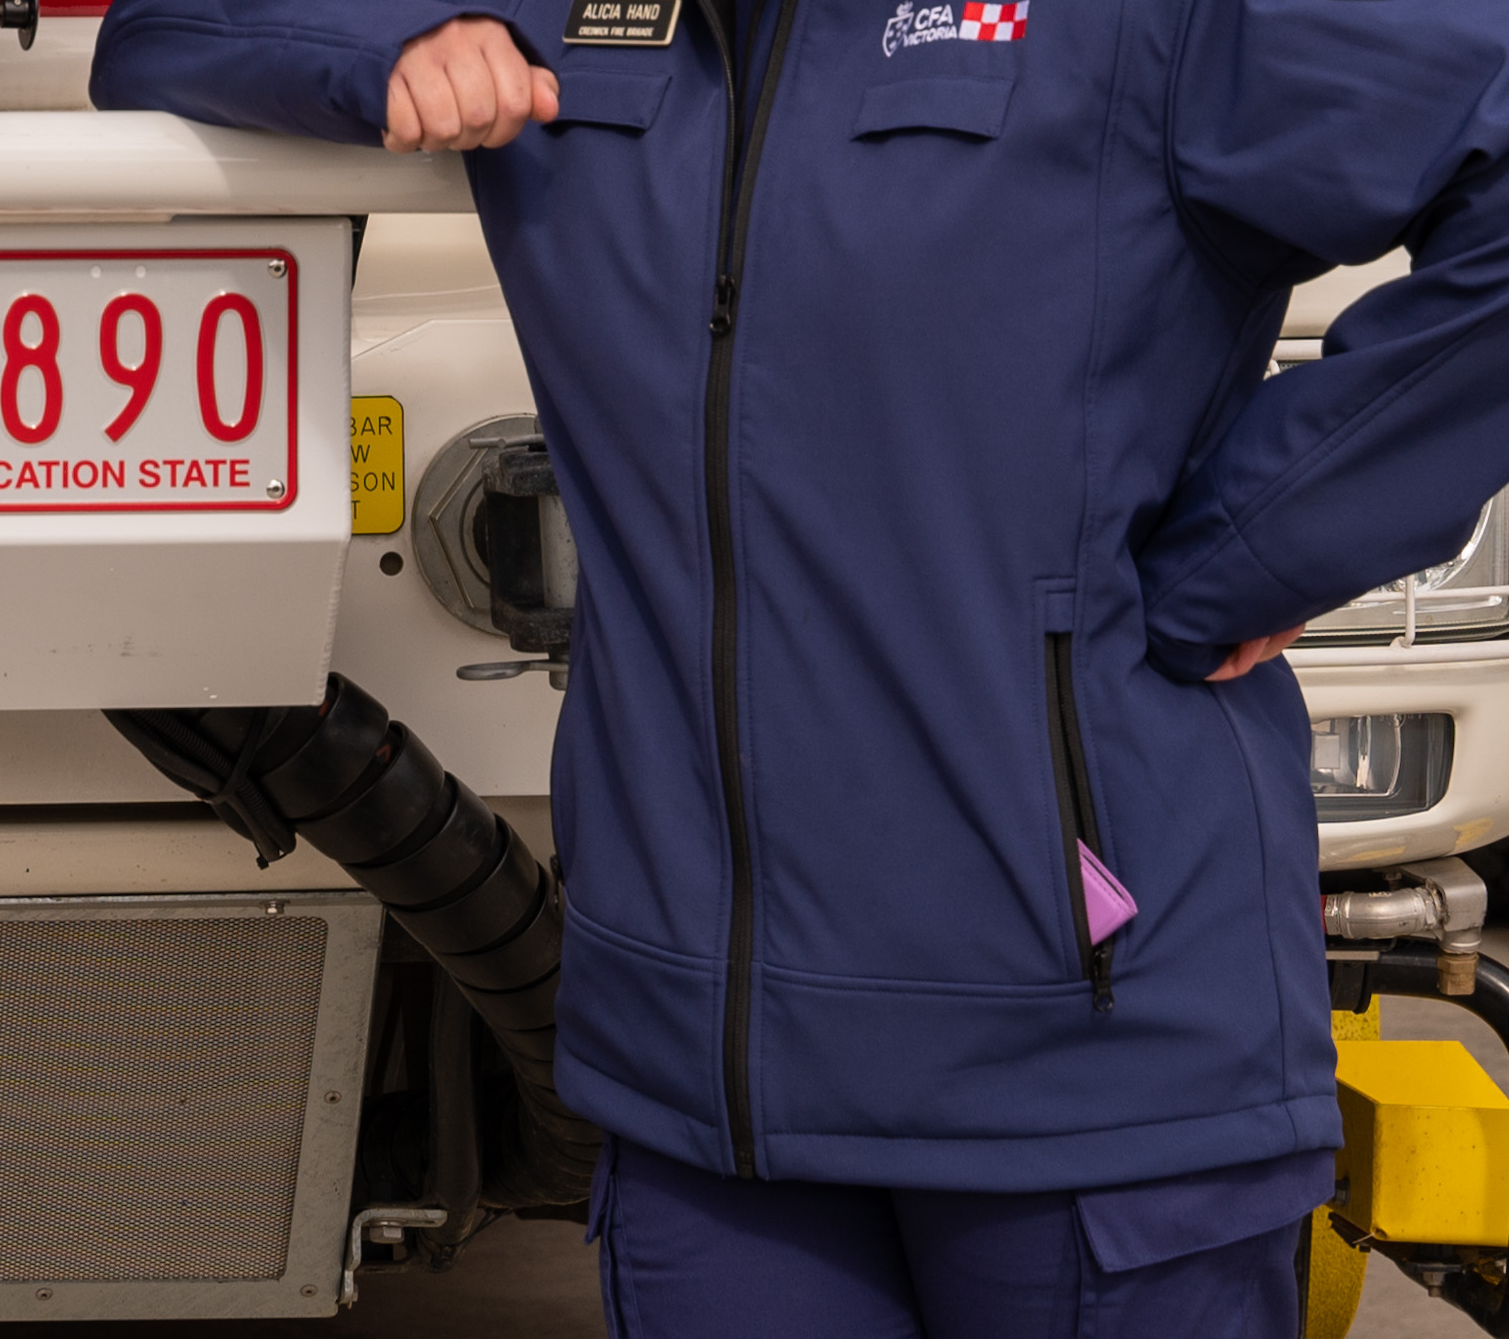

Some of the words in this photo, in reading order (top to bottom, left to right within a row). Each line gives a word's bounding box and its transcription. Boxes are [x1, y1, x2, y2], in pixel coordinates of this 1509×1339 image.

[582, 3, 621, 19] ALICIA
[626, 3, 661, 20] HAND
[914, 4, 953, 30] CFA
[902, 25, 958, 47] VICTORIA
[0, 291, 265, 446] 890
[137, 459, 251, 488] STATE
